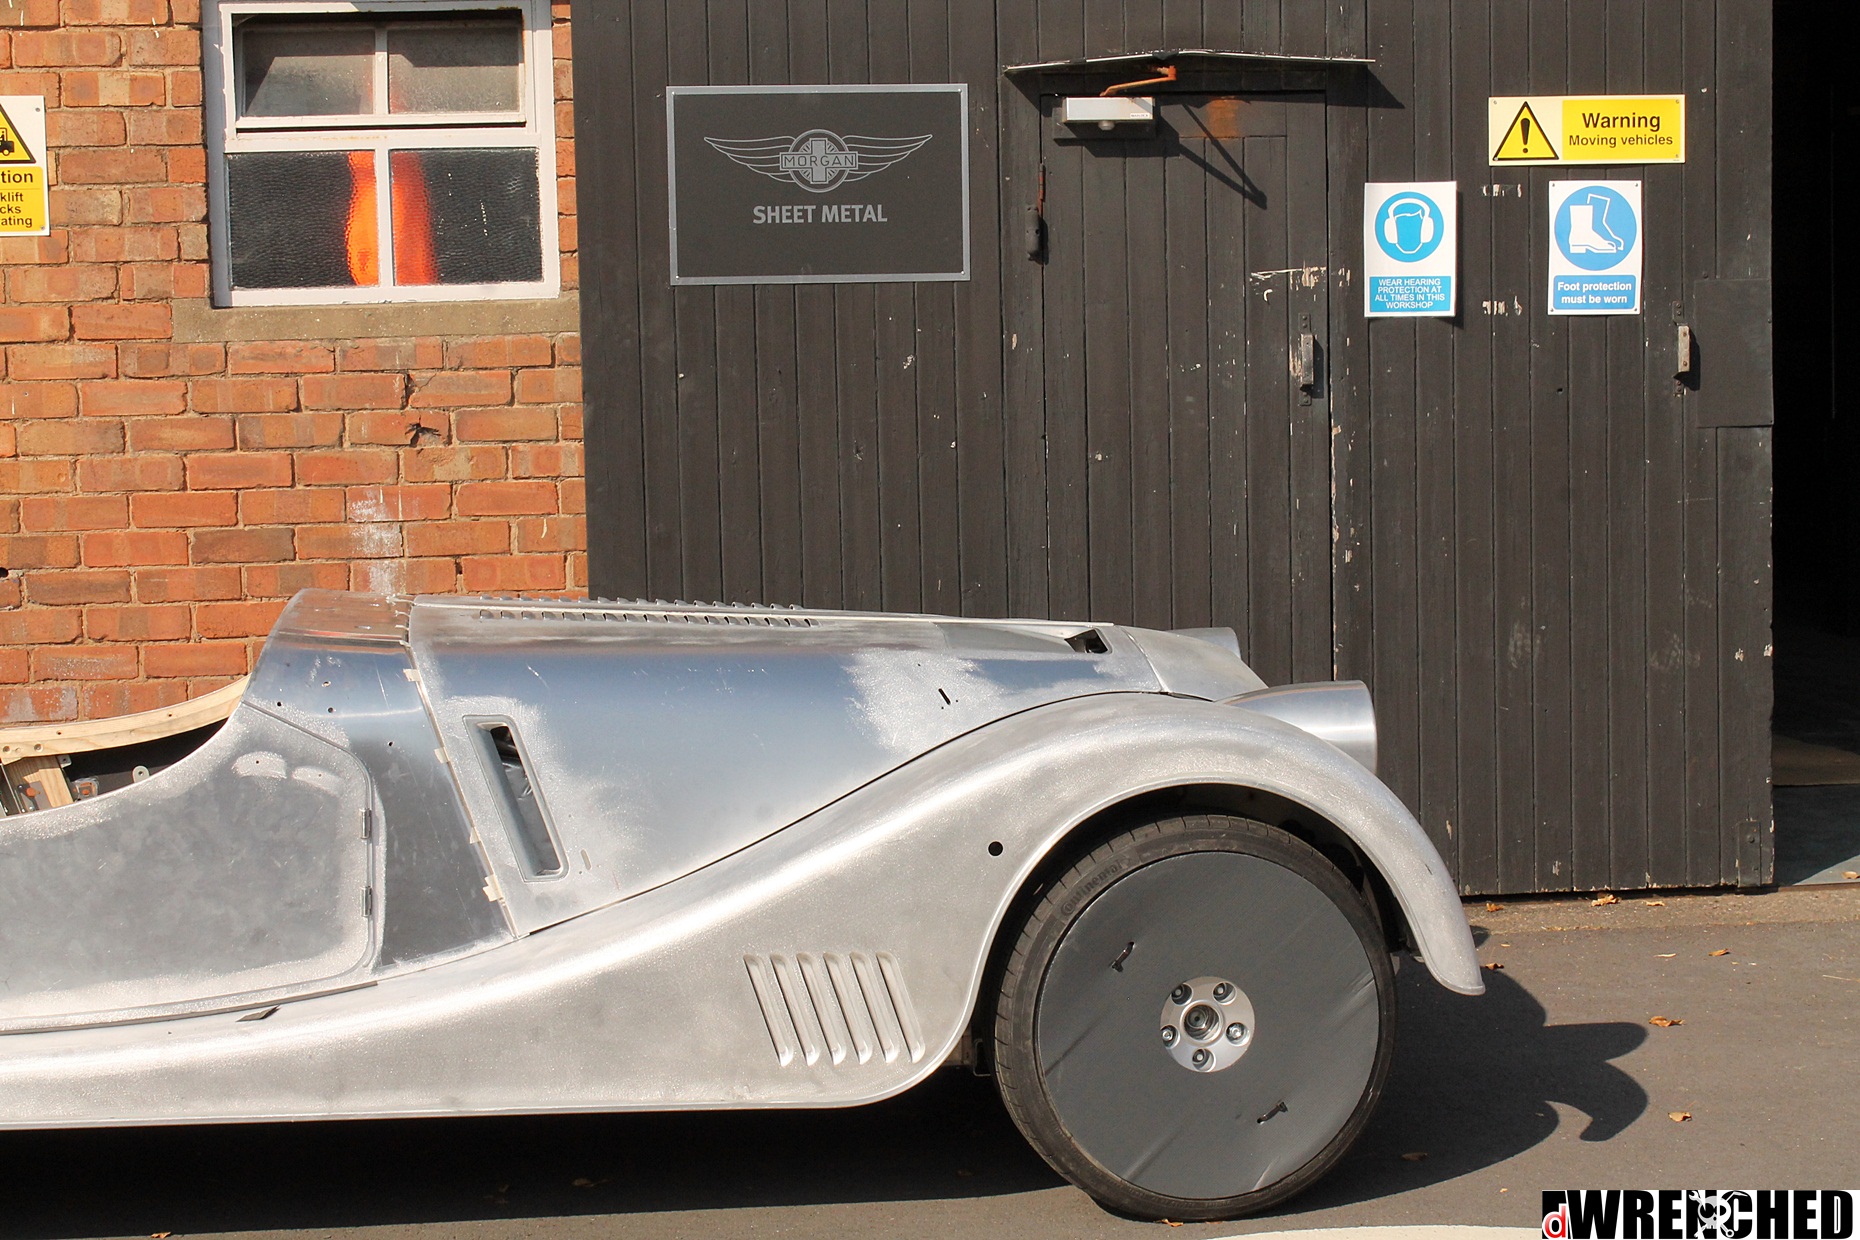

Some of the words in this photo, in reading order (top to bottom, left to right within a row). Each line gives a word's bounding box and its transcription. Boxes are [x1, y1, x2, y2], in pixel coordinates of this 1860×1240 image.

[1582, 112, 1661, 132] Warning
[1569, 135, 1617, 148] Moving
[1621, 134, 1673, 146] vehicles
[784, 155, 855, 167] MORGAN
[753, 205, 816, 224] SHEET
[821, 204, 888, 223] METAL
[1379, 278, 1402, 286] WEAR
[1404, 278, 1441, 286] HEARING
[1557, 282, 1580, 291] Foot
[1582, 281, 1632, 293] protection
[1378, 286, 1429, 294] PROTECTION
[1375, 294, 1388, 302] ALL
[1391, 293, 1415, 301] TIMES
[1417, 293, 1424, 301] IN
[1561, 295, 1586, 303] must
[1589, 294, 1601, 303] be
[1386, 301, 1433, 309] WORKSHOP
